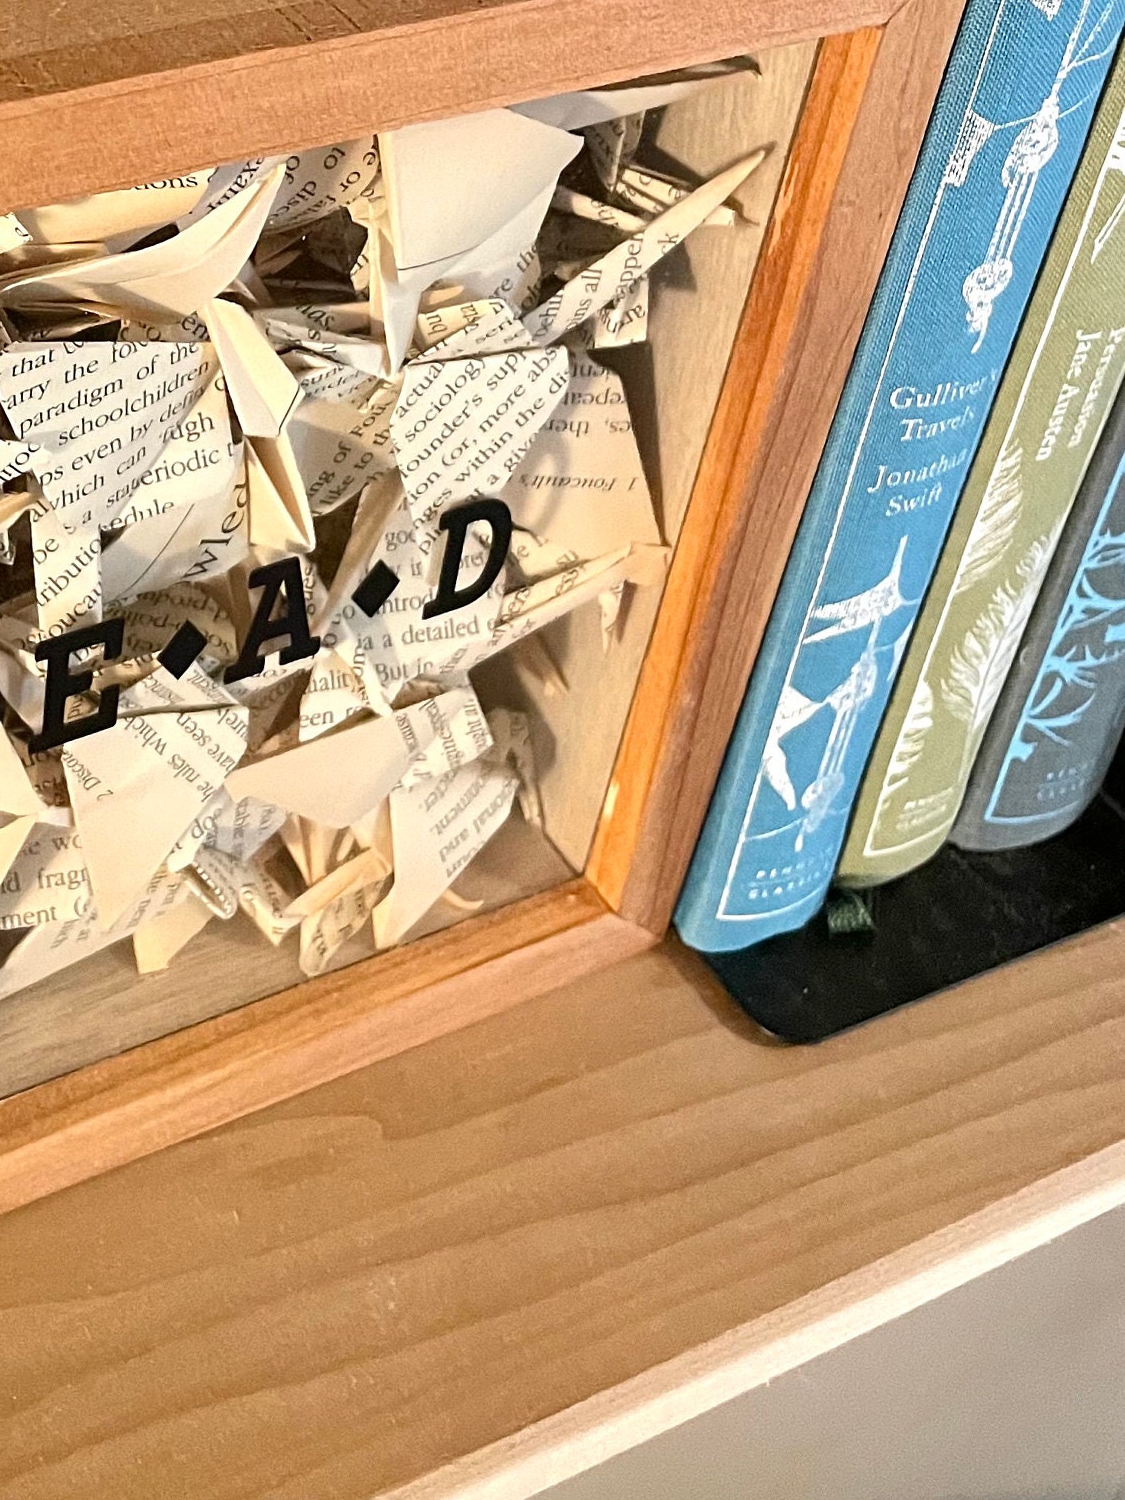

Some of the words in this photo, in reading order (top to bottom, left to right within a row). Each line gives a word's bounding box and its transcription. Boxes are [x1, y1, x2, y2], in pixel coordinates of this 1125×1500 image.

[10, 348, 56, 379] that
[63, 355, 100, 384] the
[1065, 328, 1104, 381] Jane
[18, 376, 124, 439] paradigm
[135, 357, 159, 382] of
[57, 359, 212, 447] schoolchildren
[479, 382, 528, 435] more
[454, 430, 515, 486] within
[515, 399, 546, 437] the
[1034, 382, 1081, 462] Austen
[70, 436, 124, 472] even
[885, 481, 944, 518] Swift
[401, 619, 481, 646] detailed
[167, 752, 203, 785] rules
